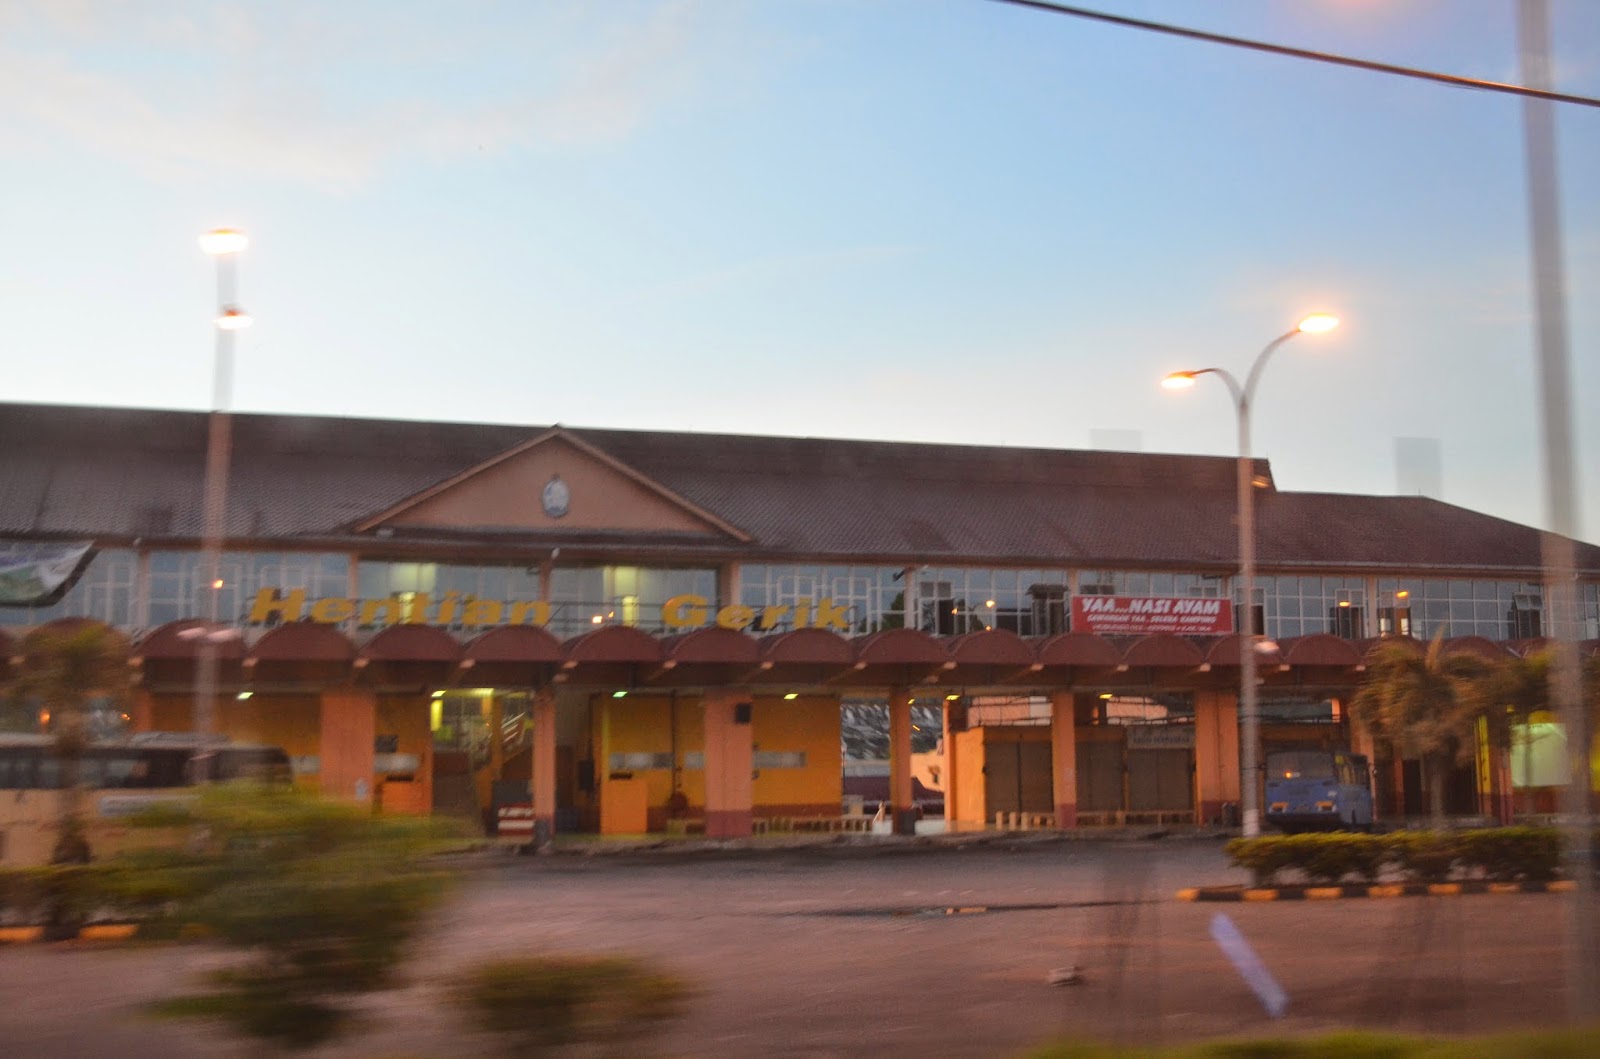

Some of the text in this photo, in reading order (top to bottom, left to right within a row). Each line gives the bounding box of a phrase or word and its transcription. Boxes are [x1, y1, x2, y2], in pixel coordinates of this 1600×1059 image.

[248, 587, 852, 630] Hentian Gerik
[1172, 600, 1221, 615] AYAM
